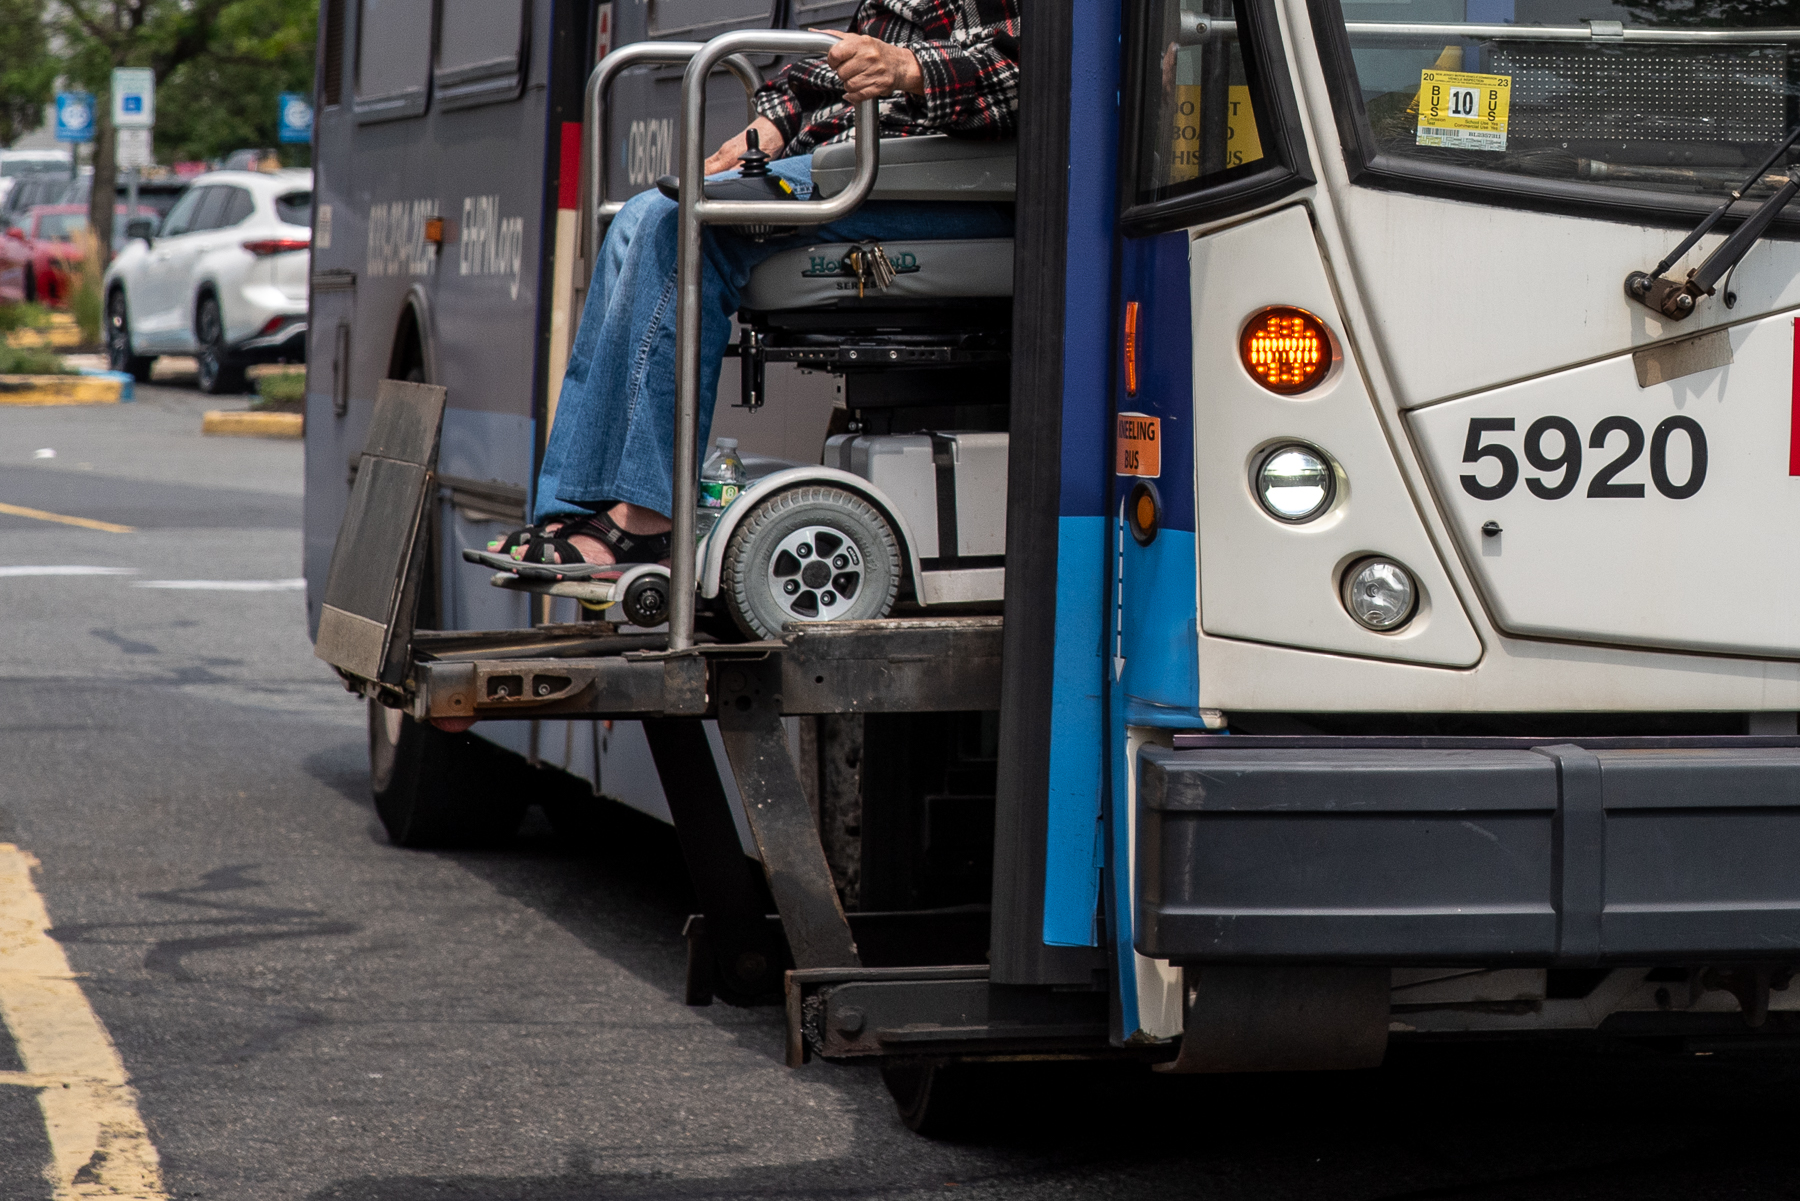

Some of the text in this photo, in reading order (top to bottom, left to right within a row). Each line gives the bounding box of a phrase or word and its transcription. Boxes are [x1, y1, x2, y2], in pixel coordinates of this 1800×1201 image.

[1423, 72, 1435, 81] 20
[1497, 78, 1509, 87] 23
[1430, 85, 1441, 117] BUS
[1452, 90, 1474, 115] 10
[1487, 90, 1498, 121] BUS
[836, 281, 877, 290] SERES
[1125, 450, 1139, 469] BUS
[1459, 414, 1708, 501] 5920
